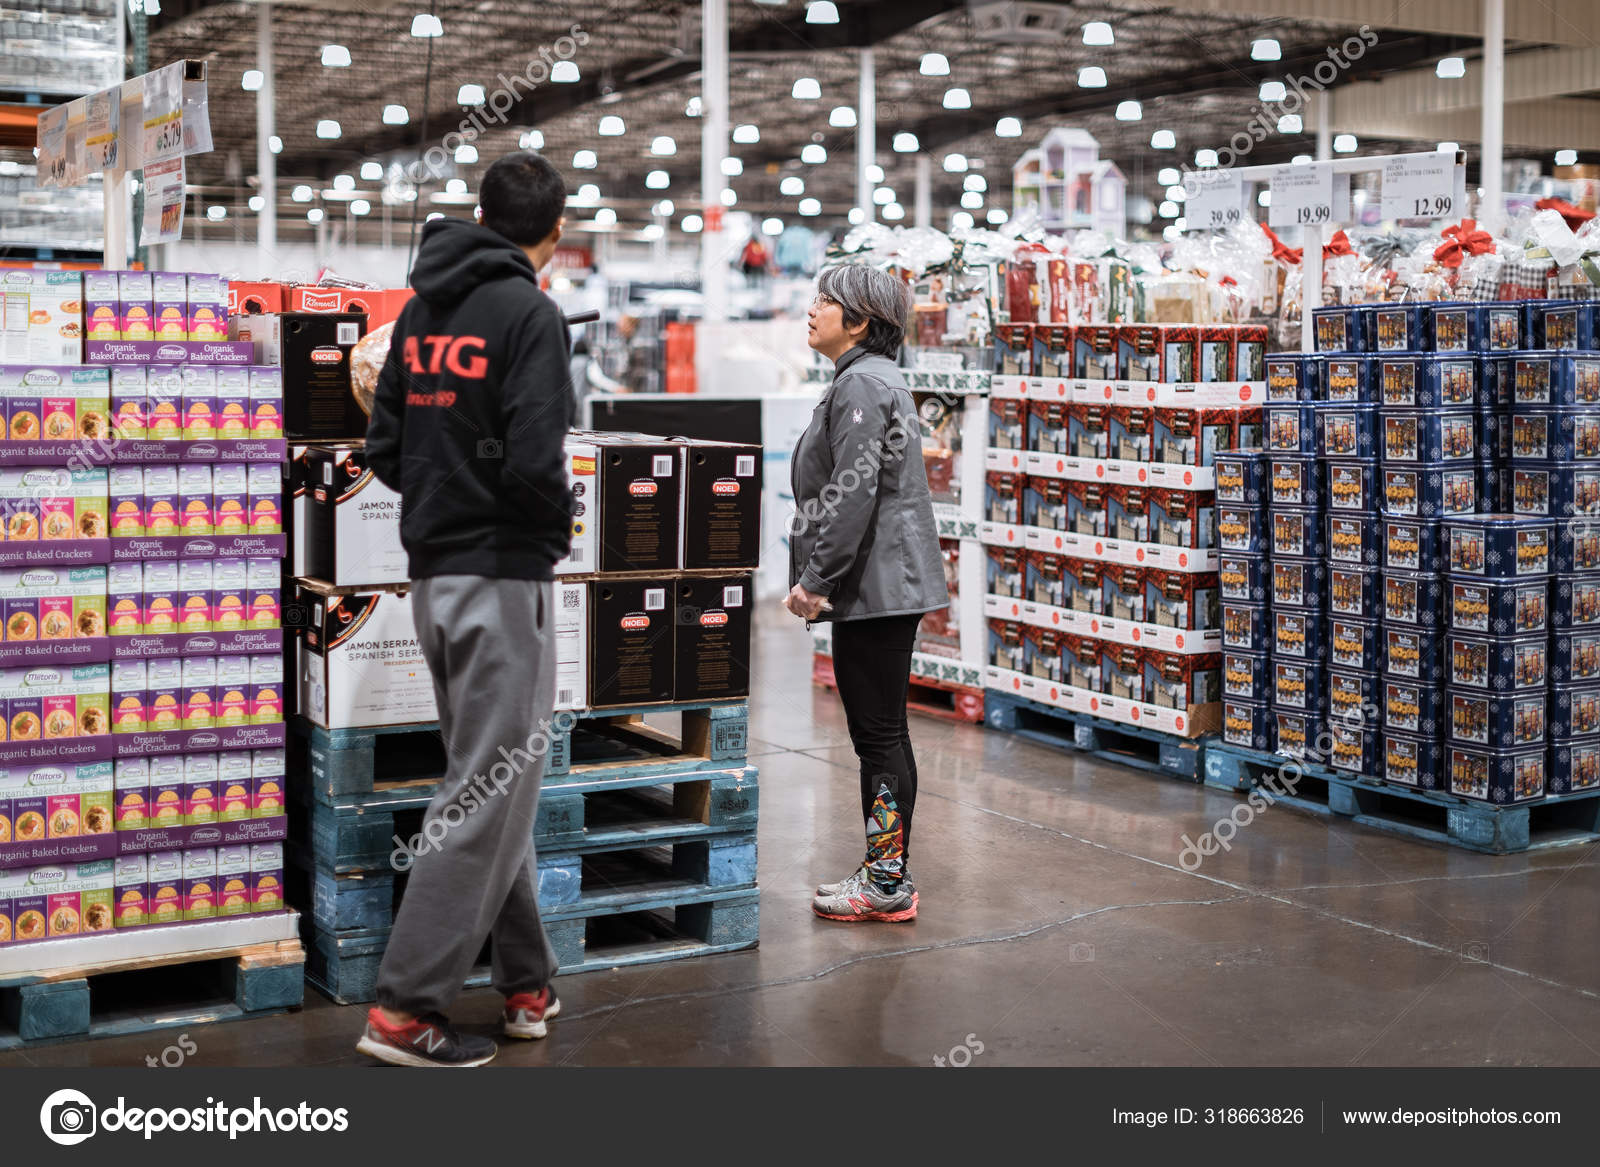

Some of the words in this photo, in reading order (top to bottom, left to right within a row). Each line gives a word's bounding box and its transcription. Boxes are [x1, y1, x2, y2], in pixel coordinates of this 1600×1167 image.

[163, 121, 181, 150] 5.79
[1414, 196, 1452, 216] 12.99
[1297, 206, 1330, 224] 19.99
[104, 343, 136, 354] Organic
[204, 344, 234, 355] Organic
[90, 351, 115, 360] Baked
[117, 351, 150, 360] Crackers
[190, 352, 215, 361] Baked
[216, 352, 248, 362] Crackers
[315, 352, 338, 361] NOEL
[402, 336, 489, 379] ATG
[133, 442, 166, 452] Organic
[236, 442, 267, 452] Organic
[1, 448, 26, 457] ganic
[117, 450, 143, 459] Baked
[144, 449, 180, 459] Crackers
[221, 450, 246, 459] Baked
[248, 450, 281, 459] Crackers
[633, 485, 654, 493] NOEL
[358, 501, 394, 511] JAMON
[362, 512, 401, 520] SPANIS
[129, 540, 162, 550] Organic
[233, 538, 265, 548] Organic
[0, 551, 24, 561] ganic
[26, 550, 53, 559] Baked
[55, 549, 92, 559] Crackers
[114, 548, 139, 558] Baked
[141, 547, 177, 557] Crackers
[219, 546, 244, 555] Baked
[246, 545, 279, 555] Crackers
[625, 619, 646, 627] NOEL
[703, 616, 726, 624] NOEL
[234, 632, 266, 642] Organic
[130, 638, 164, 648] Organic
[220, 641, 245, 651] Baked
[247, 640, 280, 649] Crackers
[344, 642, 380, 652] JAMON
[382, 639, 420, 649] SERRA
[0, 645, 23, 657] ganic
[25, 644, 52, 654] Baked
[54, 643, 91, 653] Crackers
[115, 646, 140, 655] Baked
[142, 645, 178, 655] Crackers
[348, 650, 394, 661] SPANISH
[398, 648, 424, 658] SERR
[236, 728, 268, 738] Organic
[133, 735, 166, 745] Organic
[222, 737, 248, 746] Baked
[249, 735, 282, 745] Crackers
[0, 748, 28, 760] rganic
[30, 746, 57, 755] Baked
[59, 744, 96, 754] Crackers
[118, 744, 143, 753] Baked
[144, 742, 180, 752] Crackers
[239, 821, 270, 832] Organic
[136, 831, 169, 842] Organic
[225, 831, 250, 841] Baked
[251, 829, 284, 839] Crackers
[121, 841, 146, 850] Baked
[148, 839, 183, 849] Crackers
[0, 850, 30, 861] rganic
[32, 847, 59, 857] Baked
[61, 844, 98, 855] Crackers
